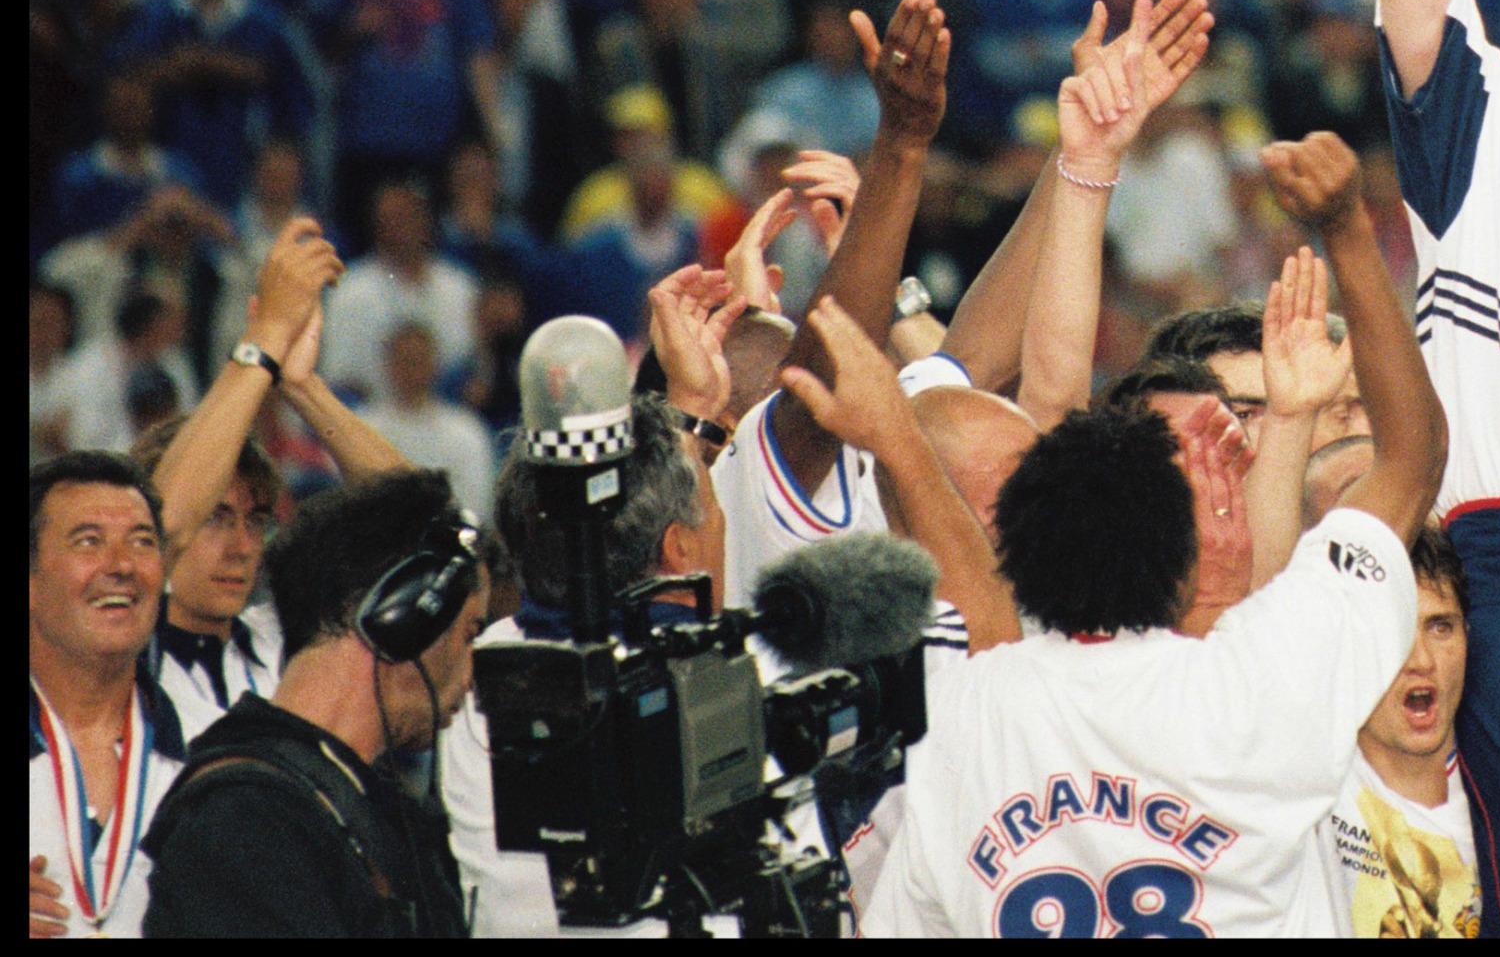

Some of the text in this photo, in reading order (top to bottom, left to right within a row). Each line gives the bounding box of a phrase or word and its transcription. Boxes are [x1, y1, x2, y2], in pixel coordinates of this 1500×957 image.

[967, 771, 1240, 891] FRANCE
[1341, 855, 1387, 881] MONDE
[992, 858, 1216, 938] 98
